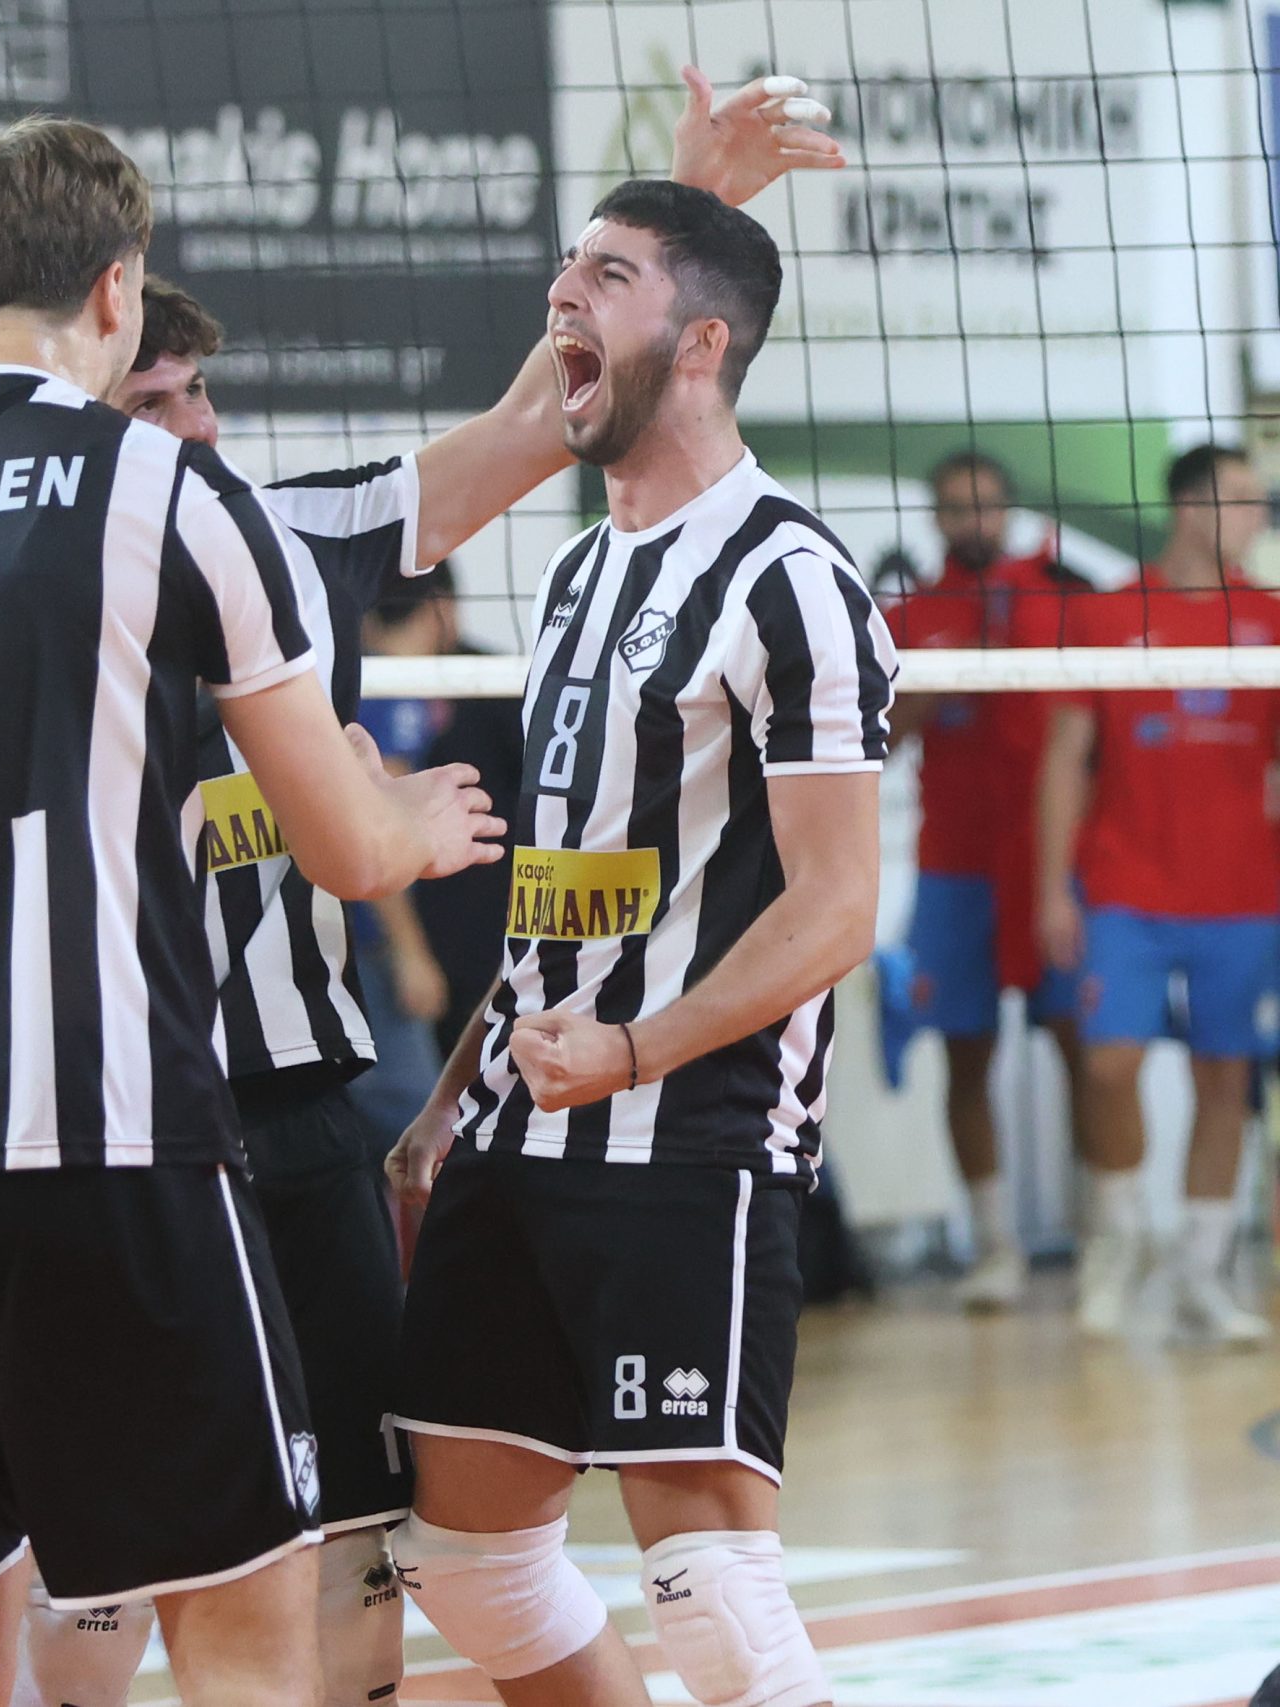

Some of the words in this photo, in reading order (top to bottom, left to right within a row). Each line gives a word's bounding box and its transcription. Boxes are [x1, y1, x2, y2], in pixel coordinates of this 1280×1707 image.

[539, 685, 591, 789] 8
[614, 1355, 647, 1419] 8
[661, 1399, 708, 1416] errea
